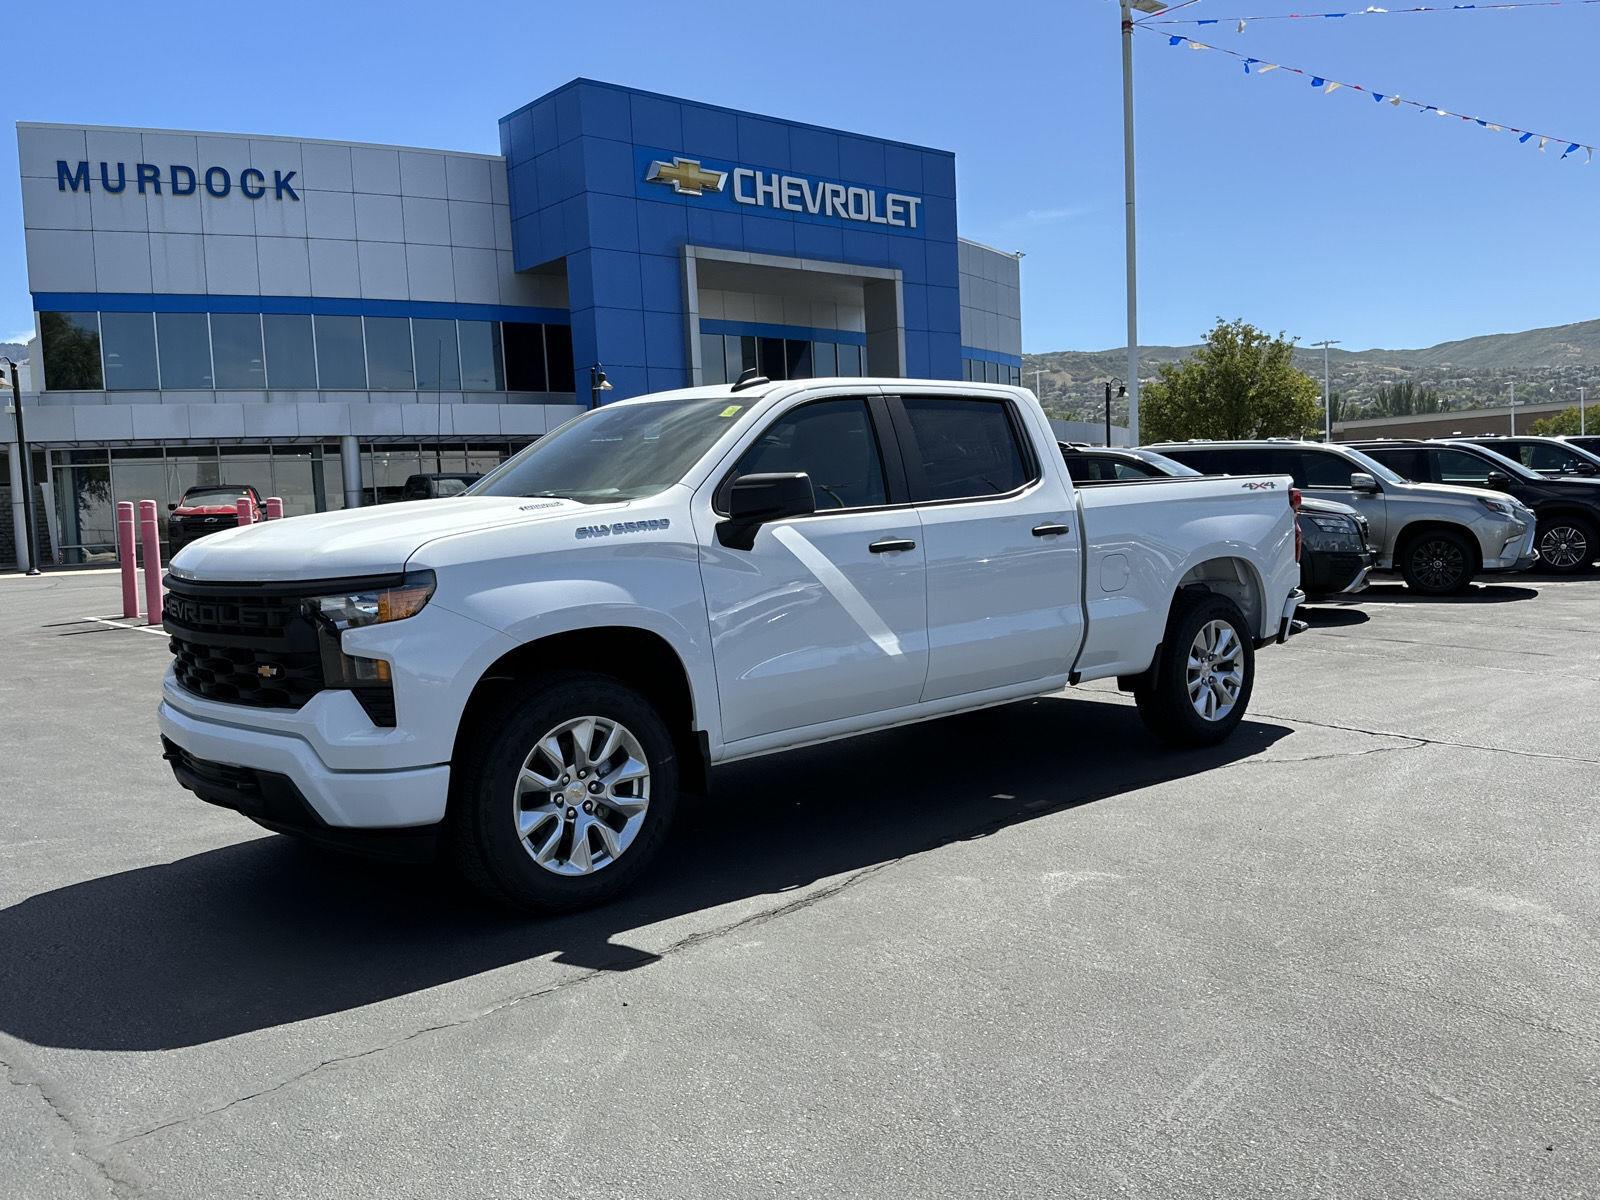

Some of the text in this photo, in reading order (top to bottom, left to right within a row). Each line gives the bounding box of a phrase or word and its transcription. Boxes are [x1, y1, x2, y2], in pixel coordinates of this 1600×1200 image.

[56, 160, 300, 201] MURDOCK
[733, 167, 922, 229] CHEVROLET
[575, 518, 671, 540] SILVERADO
[164, 595, 291, 626] HEVROLET
